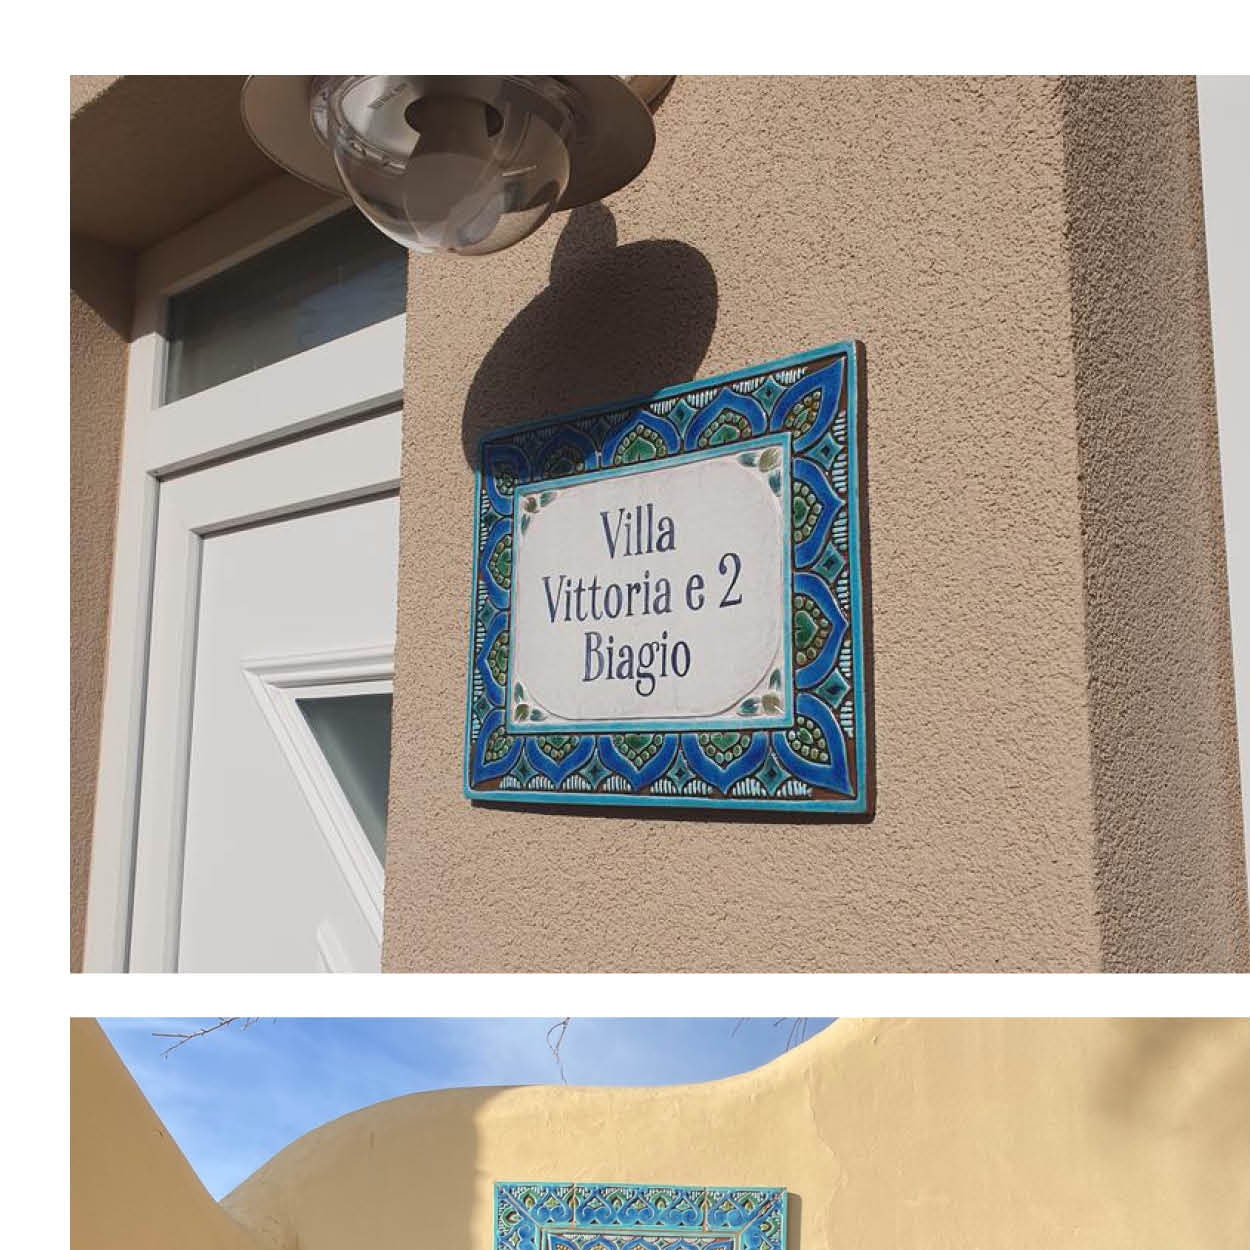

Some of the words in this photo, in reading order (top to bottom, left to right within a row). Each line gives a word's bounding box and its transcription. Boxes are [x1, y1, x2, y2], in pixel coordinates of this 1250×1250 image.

[600, 503, 677, 559] Villa
[541, 569, 673, 624] Vittoria
[686, 575, 705, 609] e
[717, 552, 744, 609] 2
[581, 630, 691, 696] Biagio
